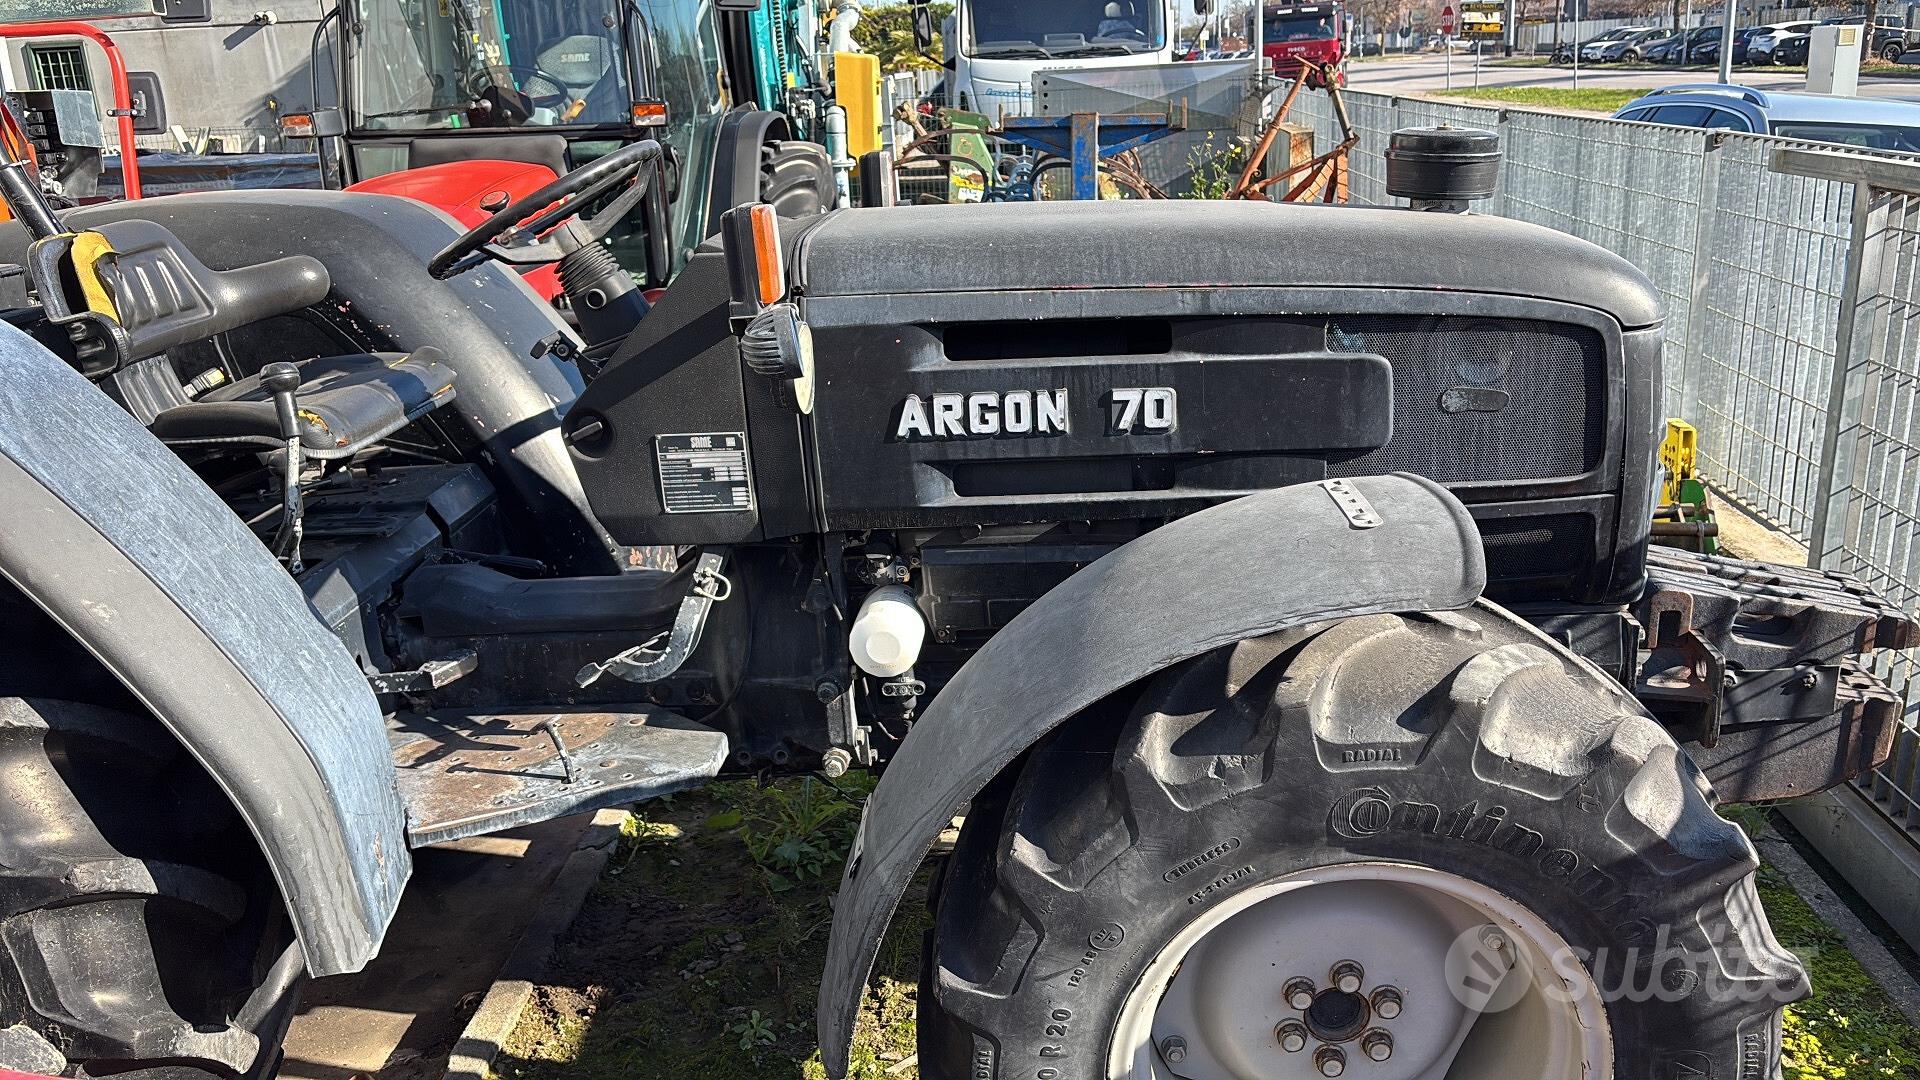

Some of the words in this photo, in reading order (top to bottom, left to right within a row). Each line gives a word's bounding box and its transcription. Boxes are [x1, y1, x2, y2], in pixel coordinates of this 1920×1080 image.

[1442, 14, 1454, 26] STOP
[897, 389, 1067, 437] ARGON
[1111, 388, 1177, 434] 70
[1342, 748, 1401, 763] RADIAL
[1169, 841, 1232, 879] TUBELESS
[1045, 1007, 1072, 1036] 20
